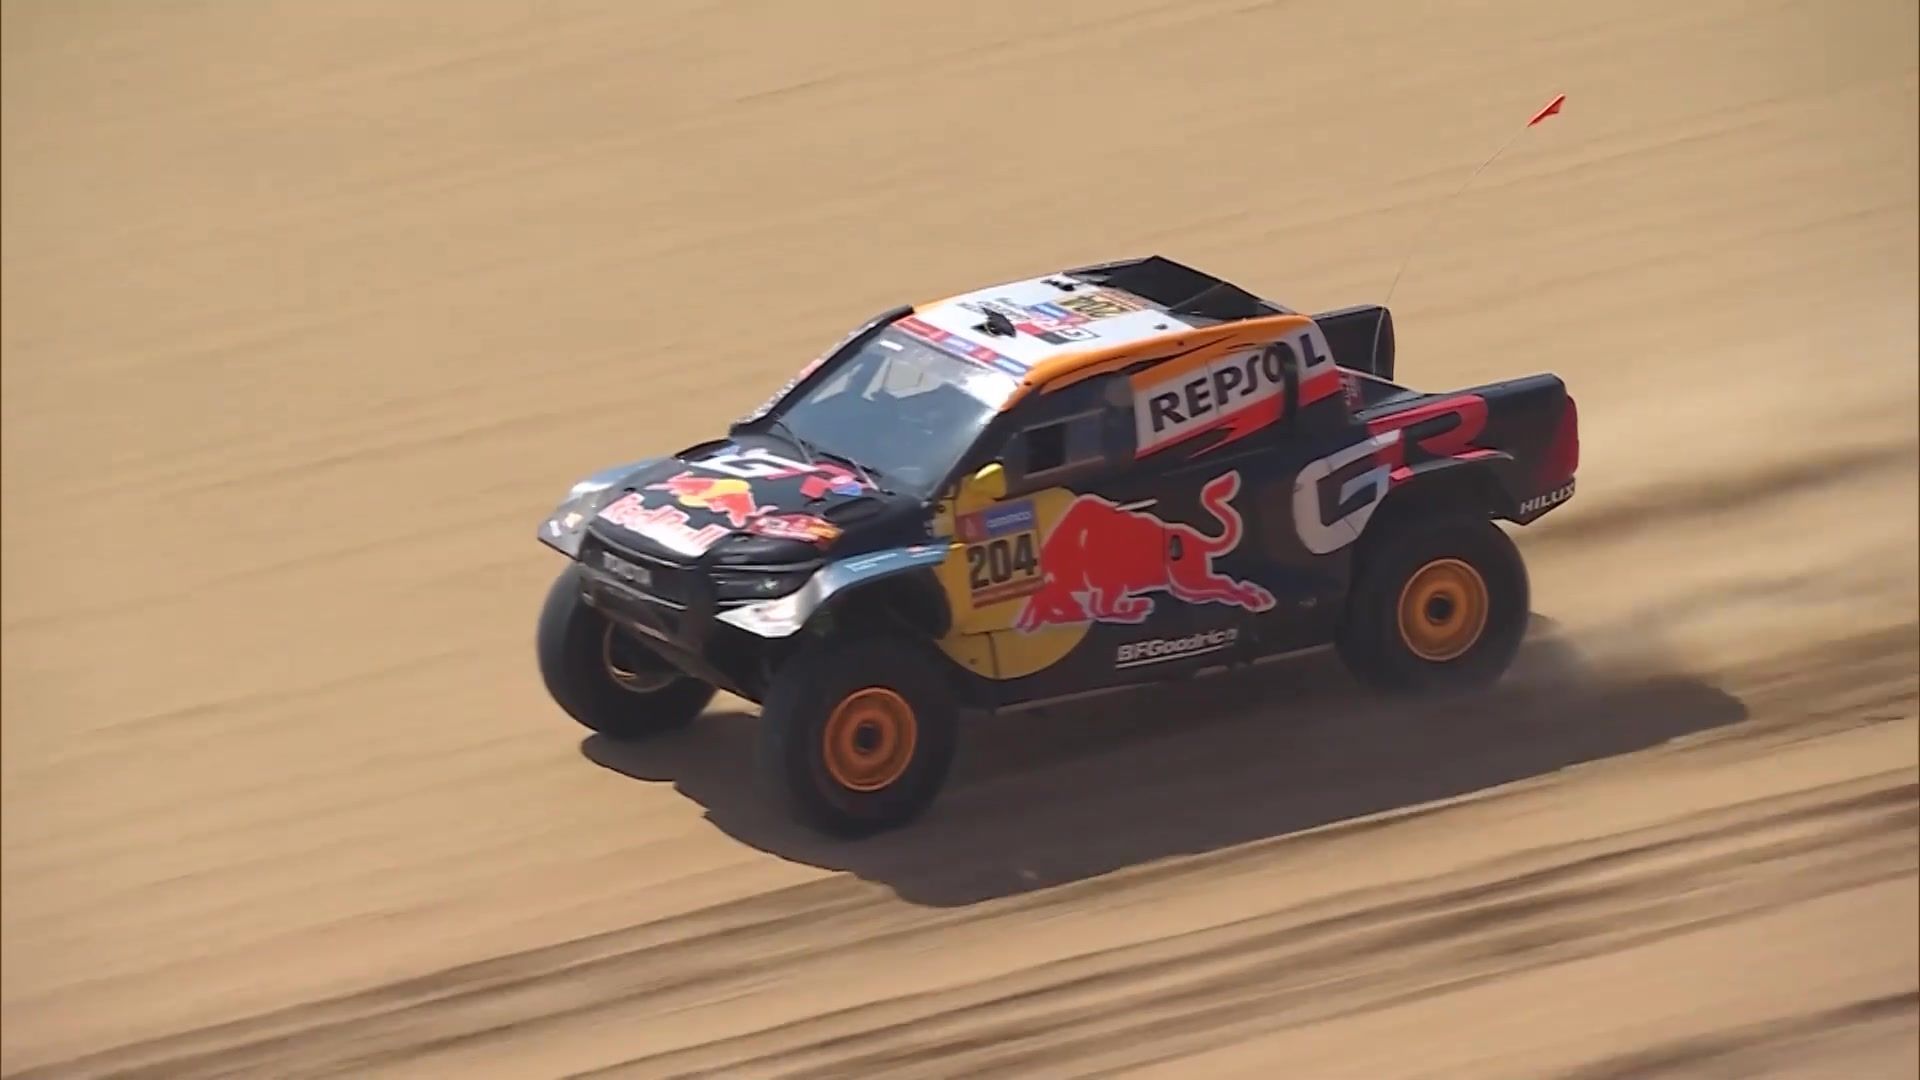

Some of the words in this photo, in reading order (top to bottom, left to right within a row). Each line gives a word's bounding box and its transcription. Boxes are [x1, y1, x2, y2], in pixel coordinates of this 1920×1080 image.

[1149, 333, 1326, 433] REPSOL
[1520, 482, 1575, 515] HILUX
[967, 533, 1038, 590] 204
